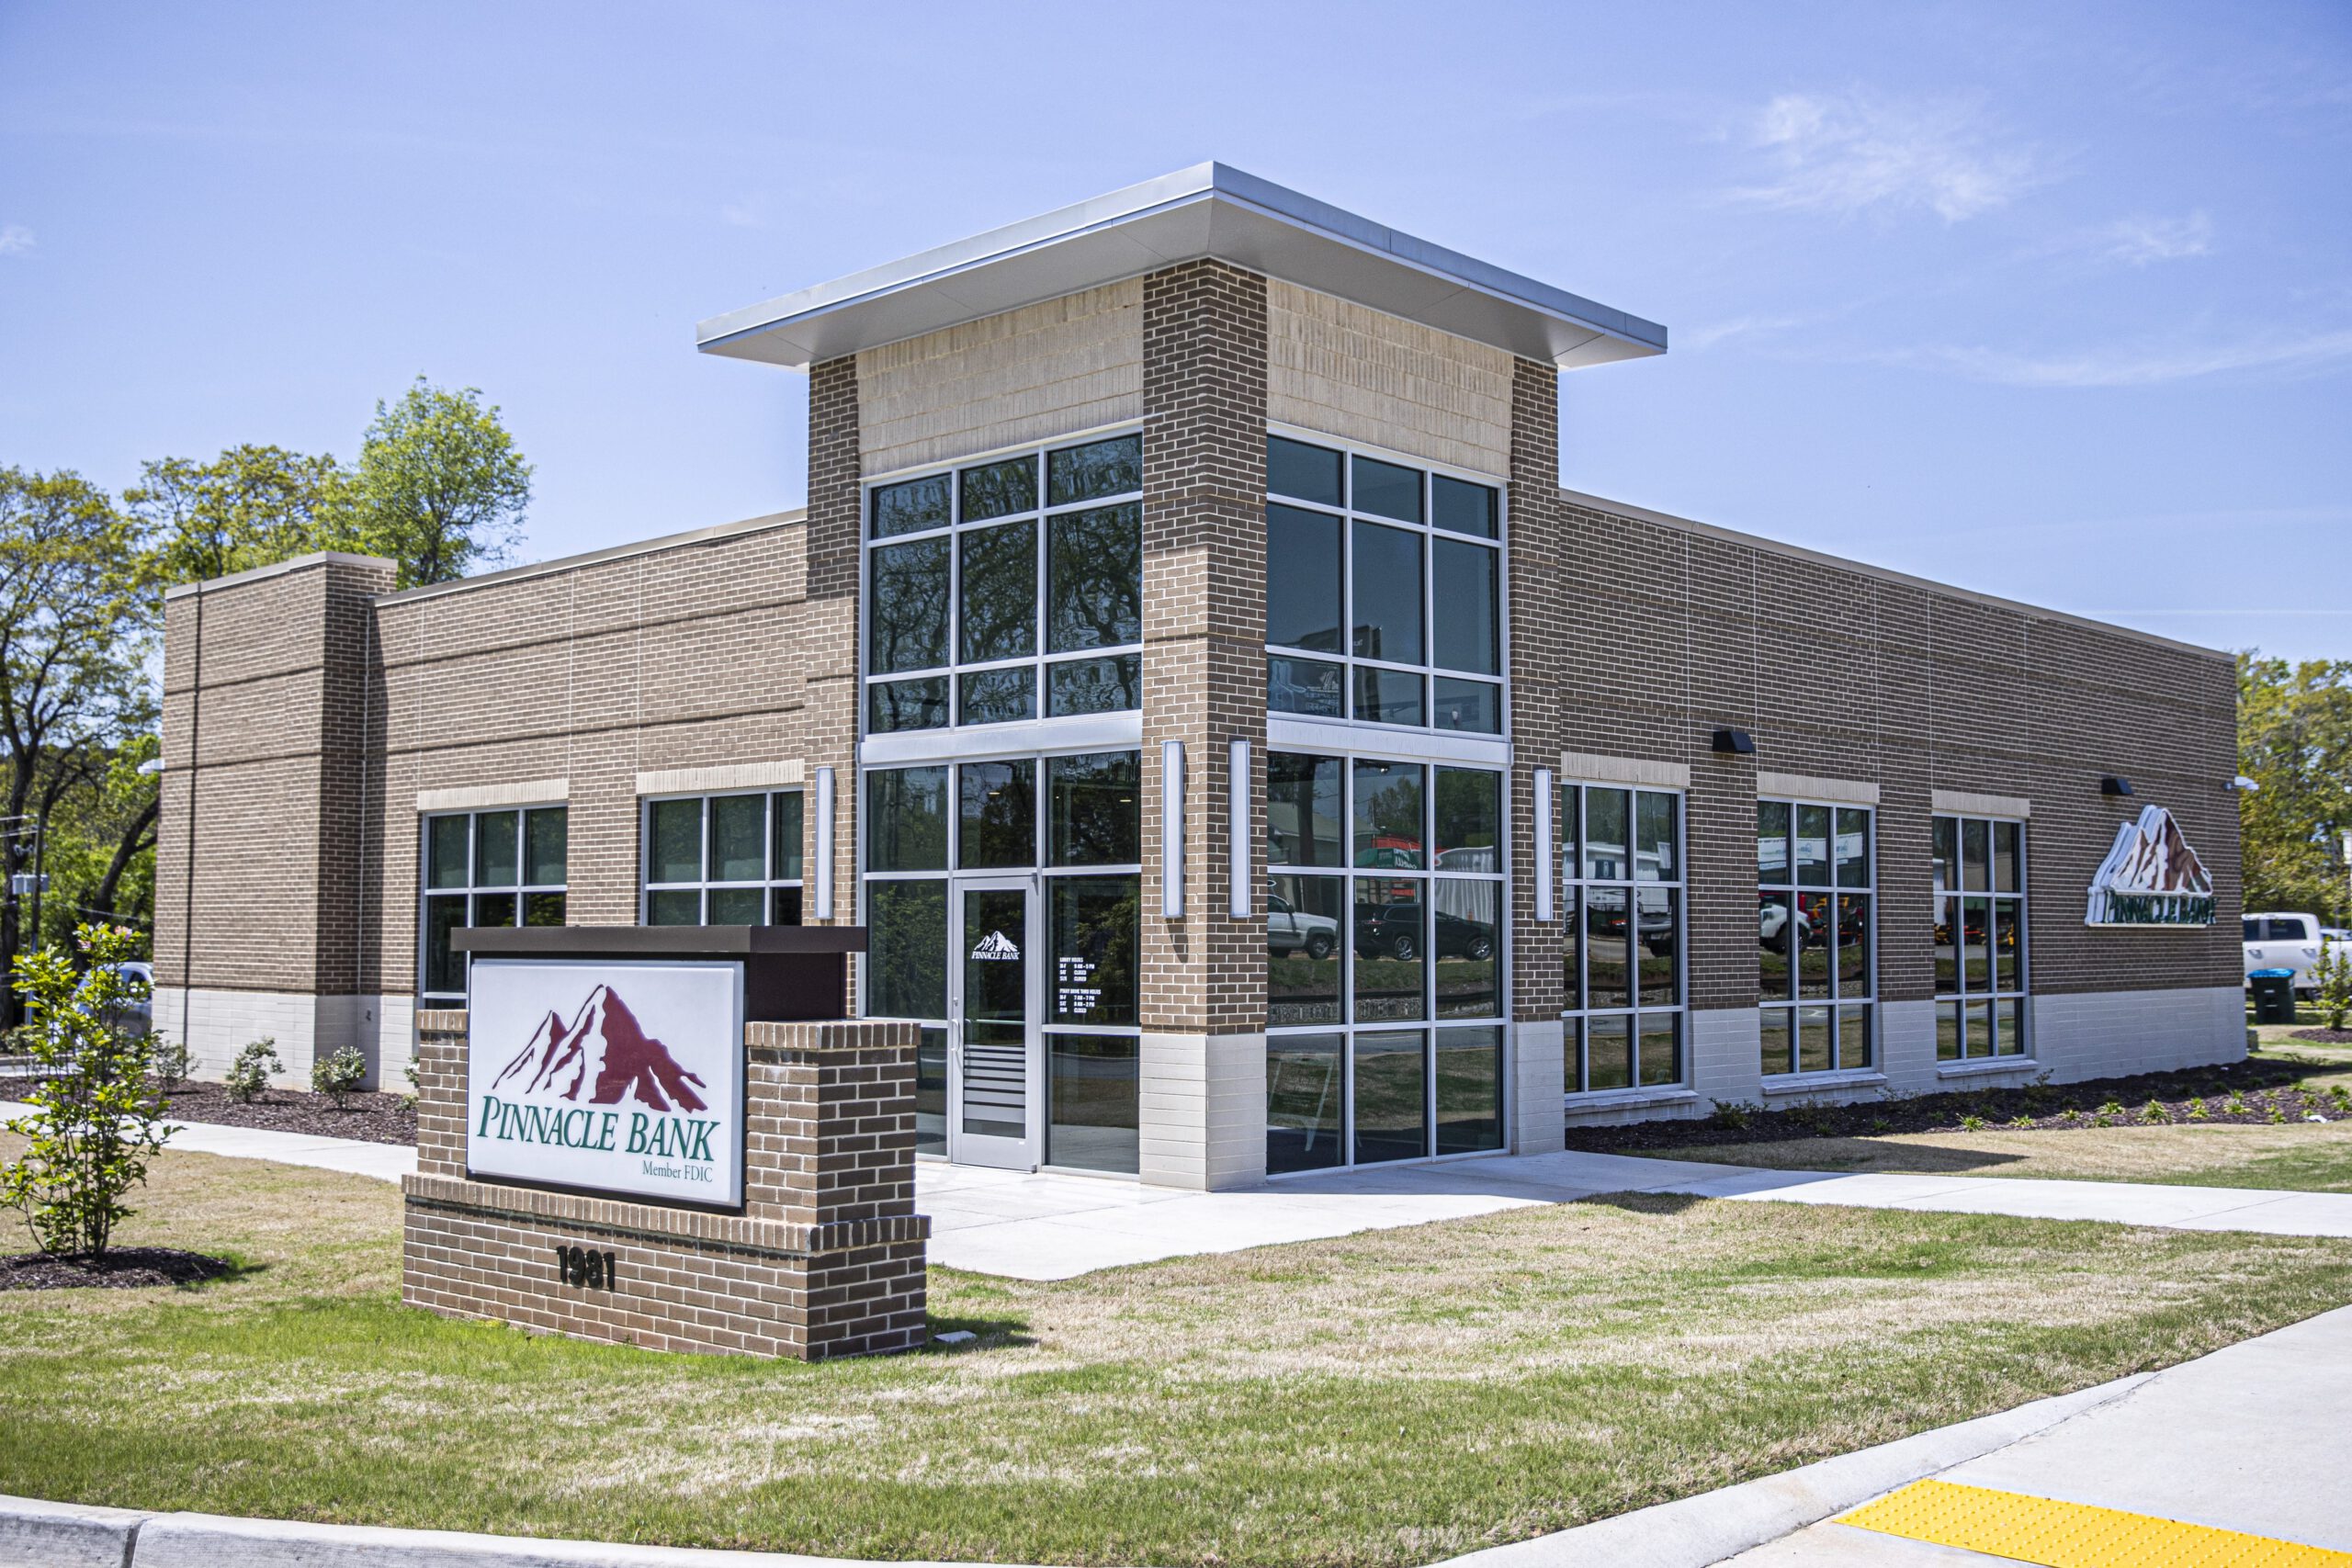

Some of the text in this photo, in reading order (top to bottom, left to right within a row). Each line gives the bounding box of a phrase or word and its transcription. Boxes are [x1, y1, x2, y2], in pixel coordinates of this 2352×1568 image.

[971, 951, 1020, 960] PINNACLE BANK
[477, 1095, 720, 1162] PINNACLE BANK
[642, 1159, 713, 1183] Member FDIC
[556, 1246, 616, 1293] 1981
